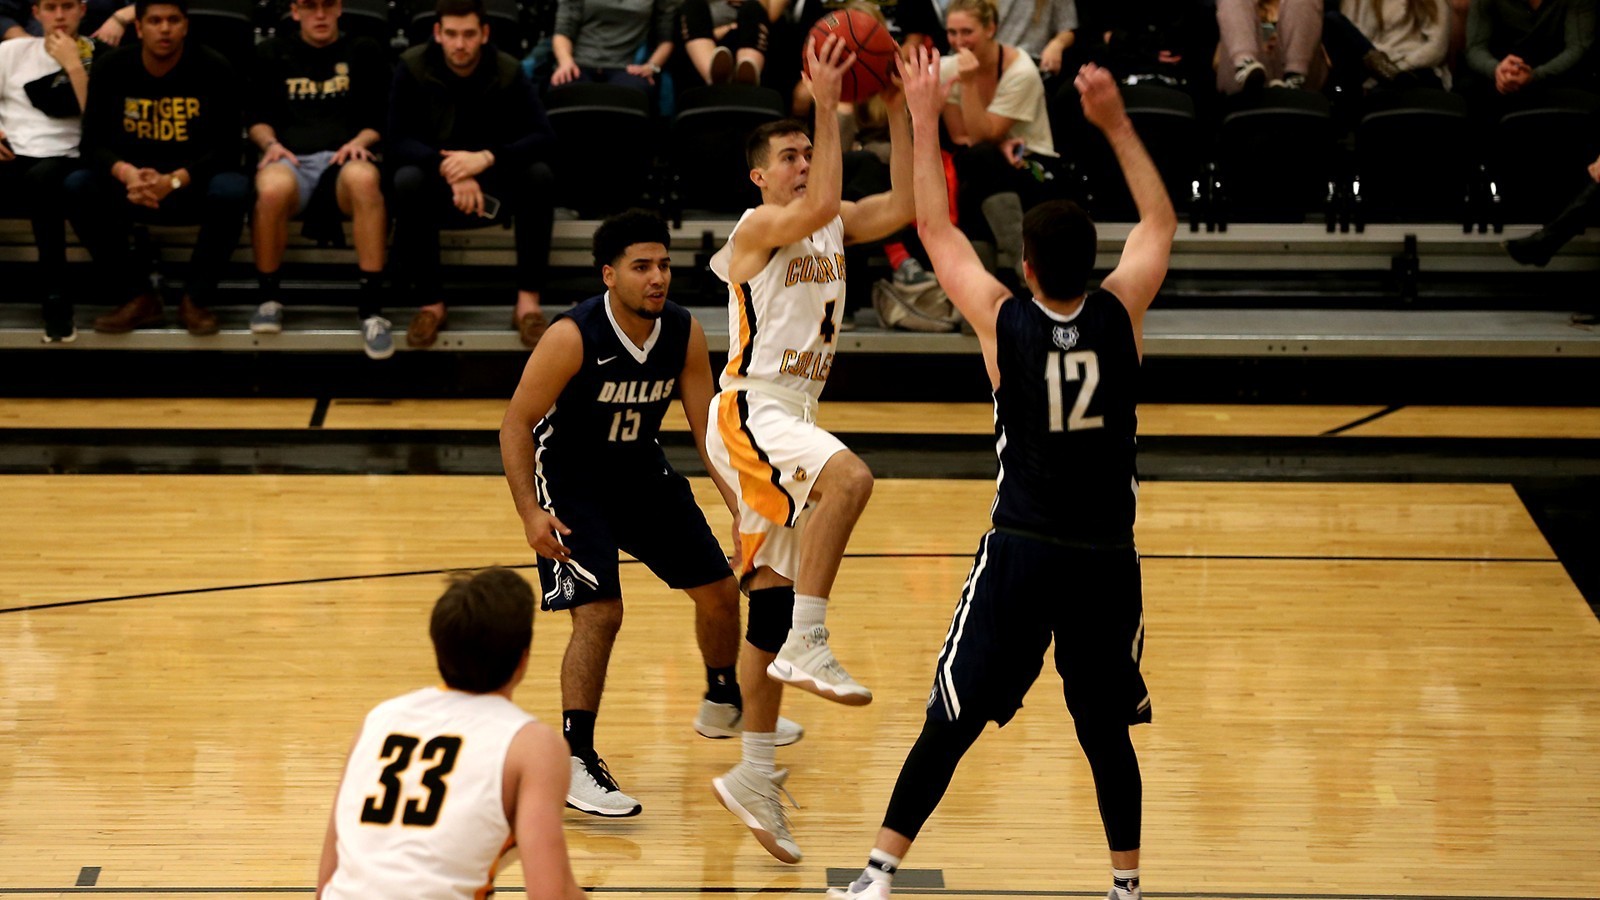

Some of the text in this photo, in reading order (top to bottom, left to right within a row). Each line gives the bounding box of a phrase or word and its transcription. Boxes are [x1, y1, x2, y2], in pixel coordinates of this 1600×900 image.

[138, 97, 200, 119] TIGER
[123, 118, 189, 141] PRIDE
[818, 299, 836, 345] 4
[596, 378, 675, 403] DALLAS
[1044, 350, 1104, 432] 12
[607, 408, 641, 442] 15
[359, 732, 464, 828] 33
